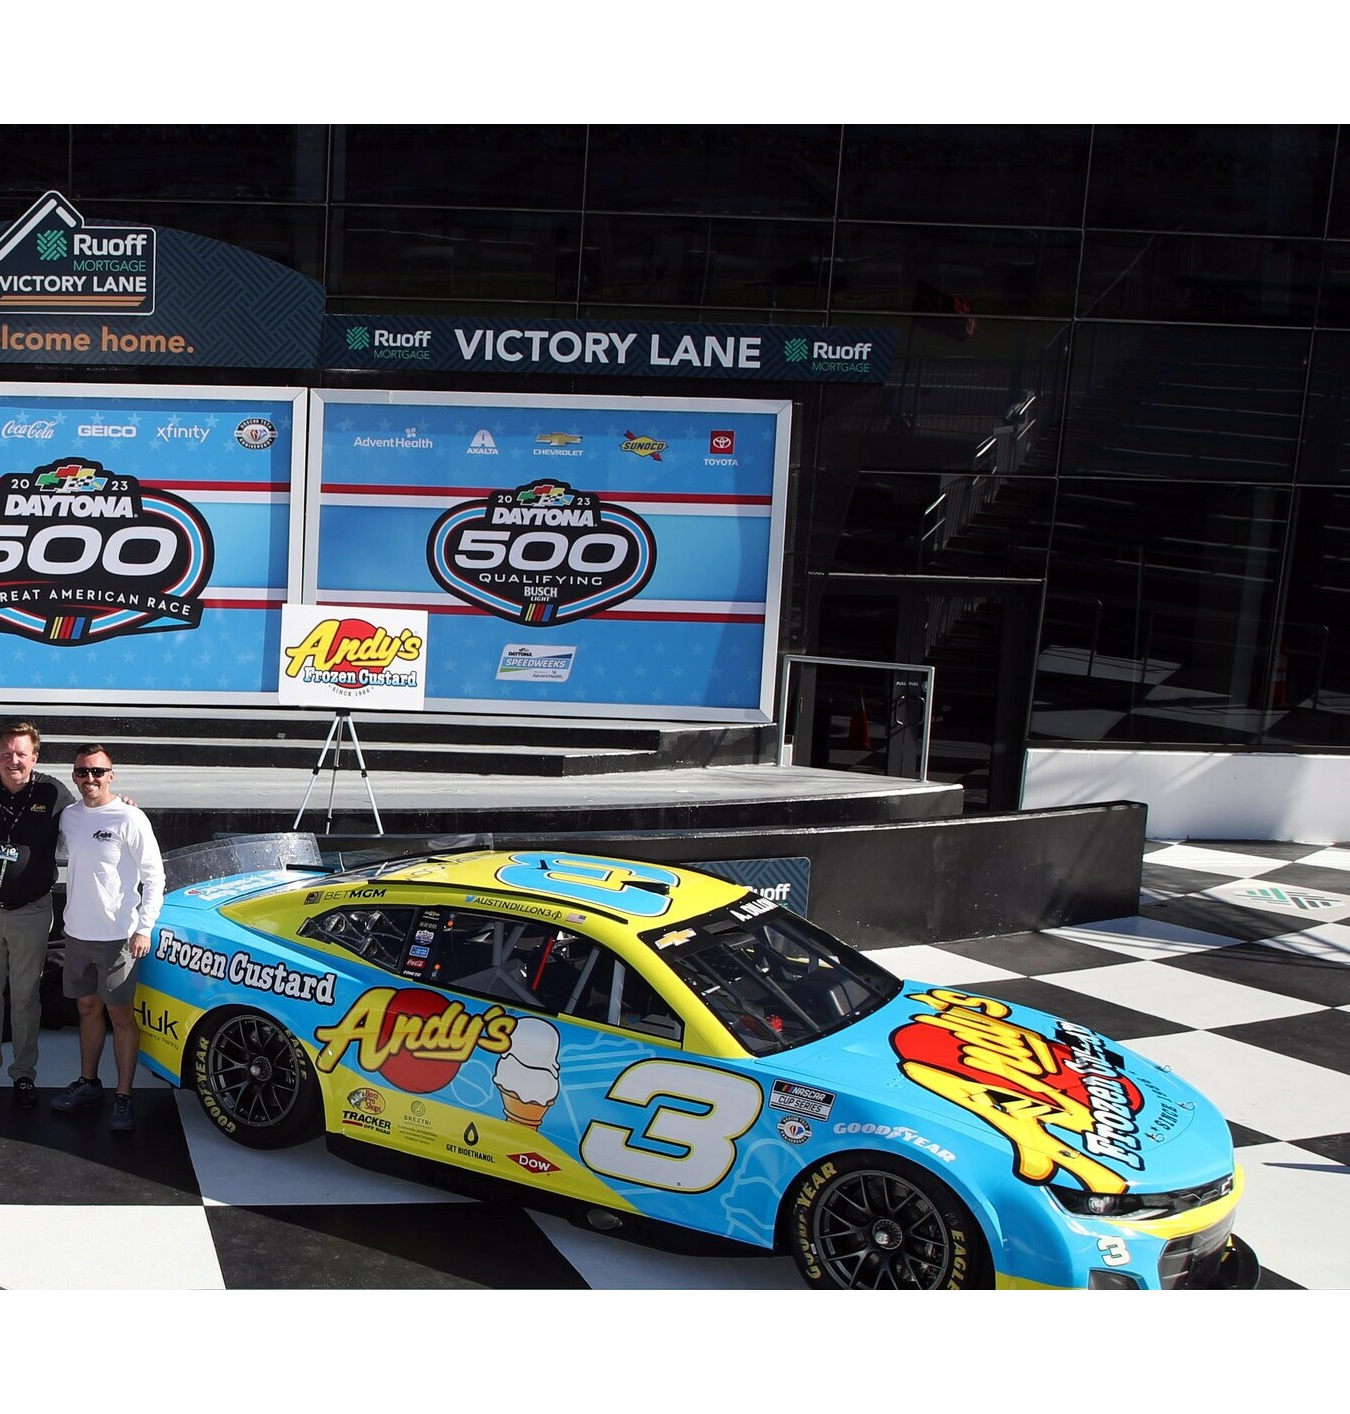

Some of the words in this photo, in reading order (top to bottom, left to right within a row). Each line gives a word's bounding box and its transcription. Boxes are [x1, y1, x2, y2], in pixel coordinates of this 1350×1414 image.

[73, 234, 148, 256] Ruoff
[73, 260, 147, 271] MORTGAGE
[92, 277, 147, 293] LANE
[102, 326, 195, 354] home.
[374, 329, 432, 347] Ruoff
[373, 350, 431, 360] MORTGAGE
[454, 328, 638, 364] VICTORY
[649, 333, 762, 369] LANE
[812, 341, 872, 360] Ruoff
[811, 361, 871, 373] MORTGAGE
[77, 424, 137, 438] GEICO
[156, 423, 210, 443] xfinity
[353, 436, 433, 448] AdventHealth
[466, 447, 499, 455] AXALTA
[623, 442, 666, 451] SUNOCO
[703, 458, 739, 466] TOYOTA
[10, 478, 30, 489] 20
[111, 480, 129, 492] 23
[4, 494, 134, 519] DAYTONA
[497, 494, 513, 504] 20
[577, 497, 591, 506] 23
[491, 507, 595, 528] DAYTONA
[454, 530, 630, 574] 500
[479, 572, 604, 586] QUALIFYING
[523, 586, 559, 598] BUSCH
[48, 589, 140, 606] AMERICAN
[147, 596, 192, 616] RACE
[285, 618, 423, 678] Andy's
[505, 658, 567, 669] SPEEDWEEKS
[302, 665, 357, 685] Frozen
[358, 667, 419, 689] Custard
[331, 685, 352, 697] SINCE
[495, 851, 681, 917] 3
[324, 888, 387, 900] BETMGM
[474, 897, 552, 917] AUSTINDILLON3
[156, 928, 228, 980] Frozen
[227, 951, 337, 1006] Custard
[313, 986, 518, 1074] Andy's
[792, 1086, 827, 1102] NASCAR
[778, 1095, 795, 1105] CUP
[794, 1099, 823, 1113] SERIES
[342, 1110, 392, 1130] TRACKER
[363, 1123, 375, 1131] OFF
[375, 1127, 391, 1135] ROAD
[403, 1114, 433, 1126] BREZTRI
[579, 1057, 764, 1195] 3
[1081, 1074, 1146, 1172] Frozen
[832, 1122, 957, 1163] GOODYEAR
[445, 1143, 458, 1154] GET
[457, 1146, 496, 1164] BIOETHANOL
[1096, 1235, 1131, 1267] 3
